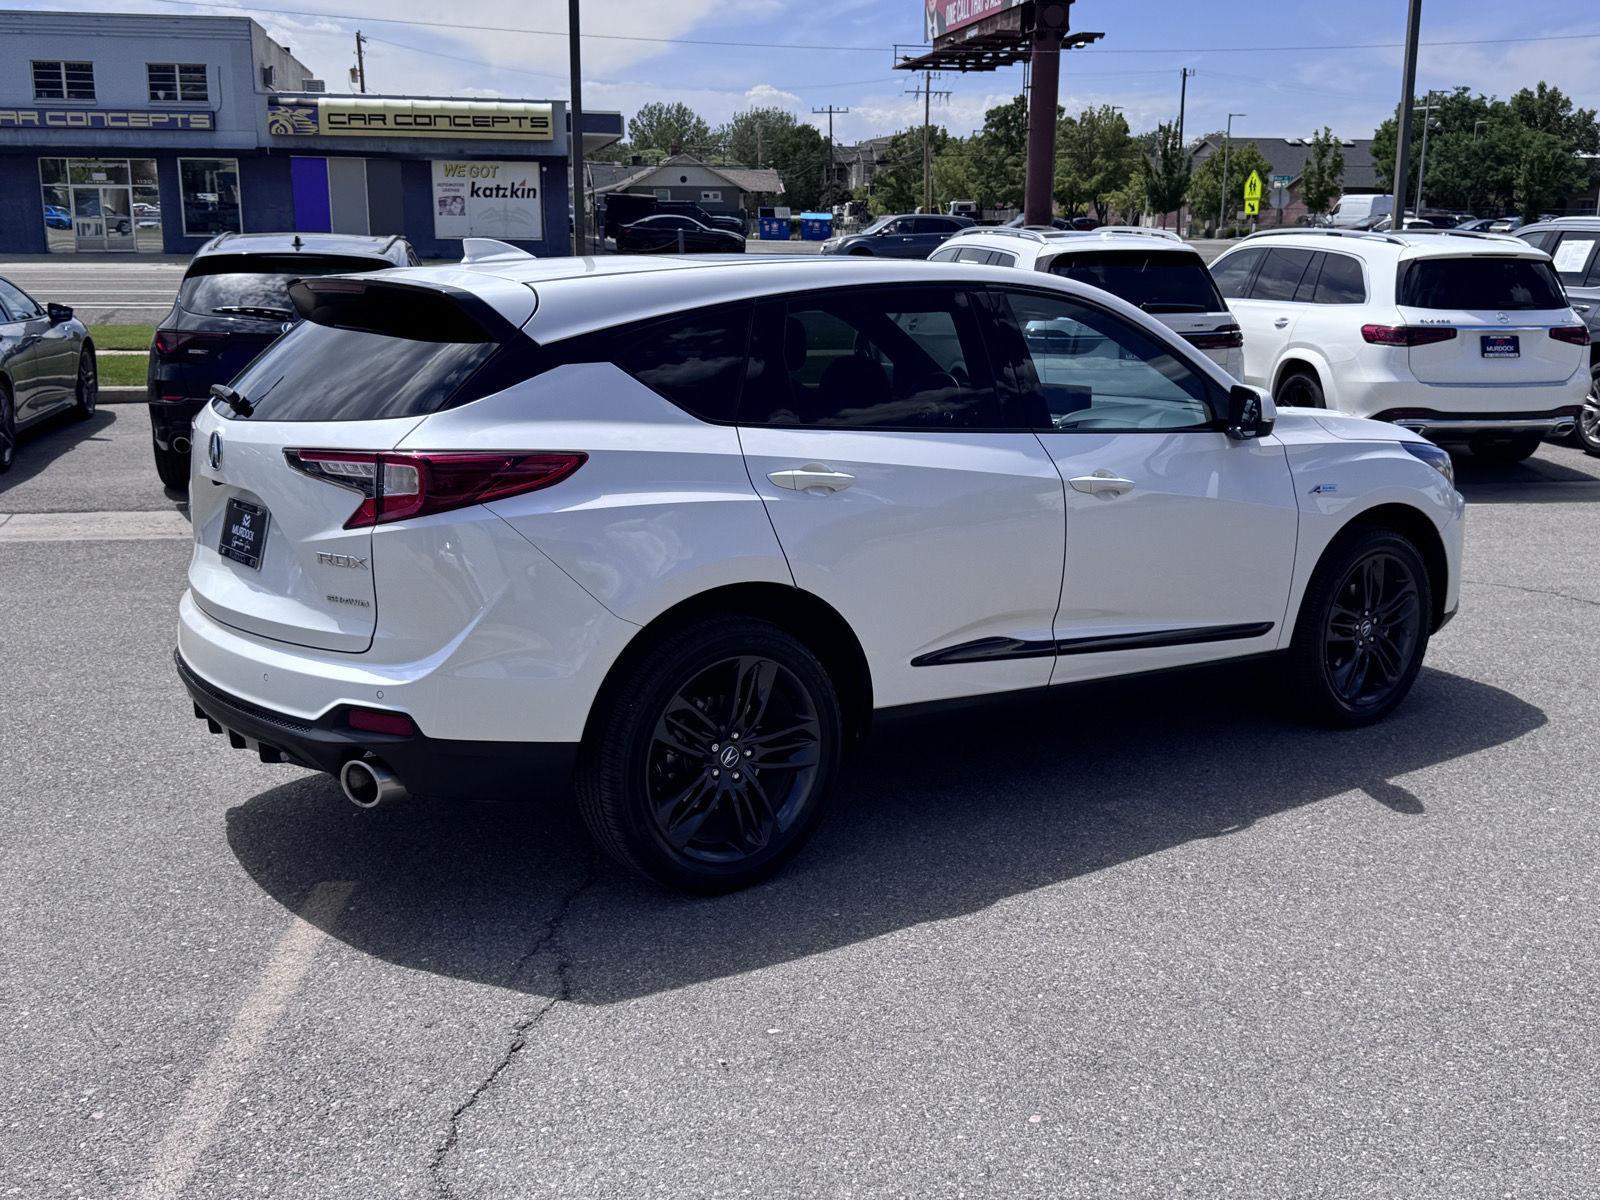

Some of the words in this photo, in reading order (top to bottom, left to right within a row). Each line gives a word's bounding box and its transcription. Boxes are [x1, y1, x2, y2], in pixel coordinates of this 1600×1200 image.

[45, 111, 210, 128] CONCEPTS
[327, 113, 388, 126] CAR
[394, 114, 550, 128] CONCEPTS
[443, 162, 466, 177] WE
[469, 164, 499, 178] GOT
[470, 180, 537, 199] katzkin
[231, 523, 255, 542] MURDOCK
[316, 551, 369, 570] RDX
